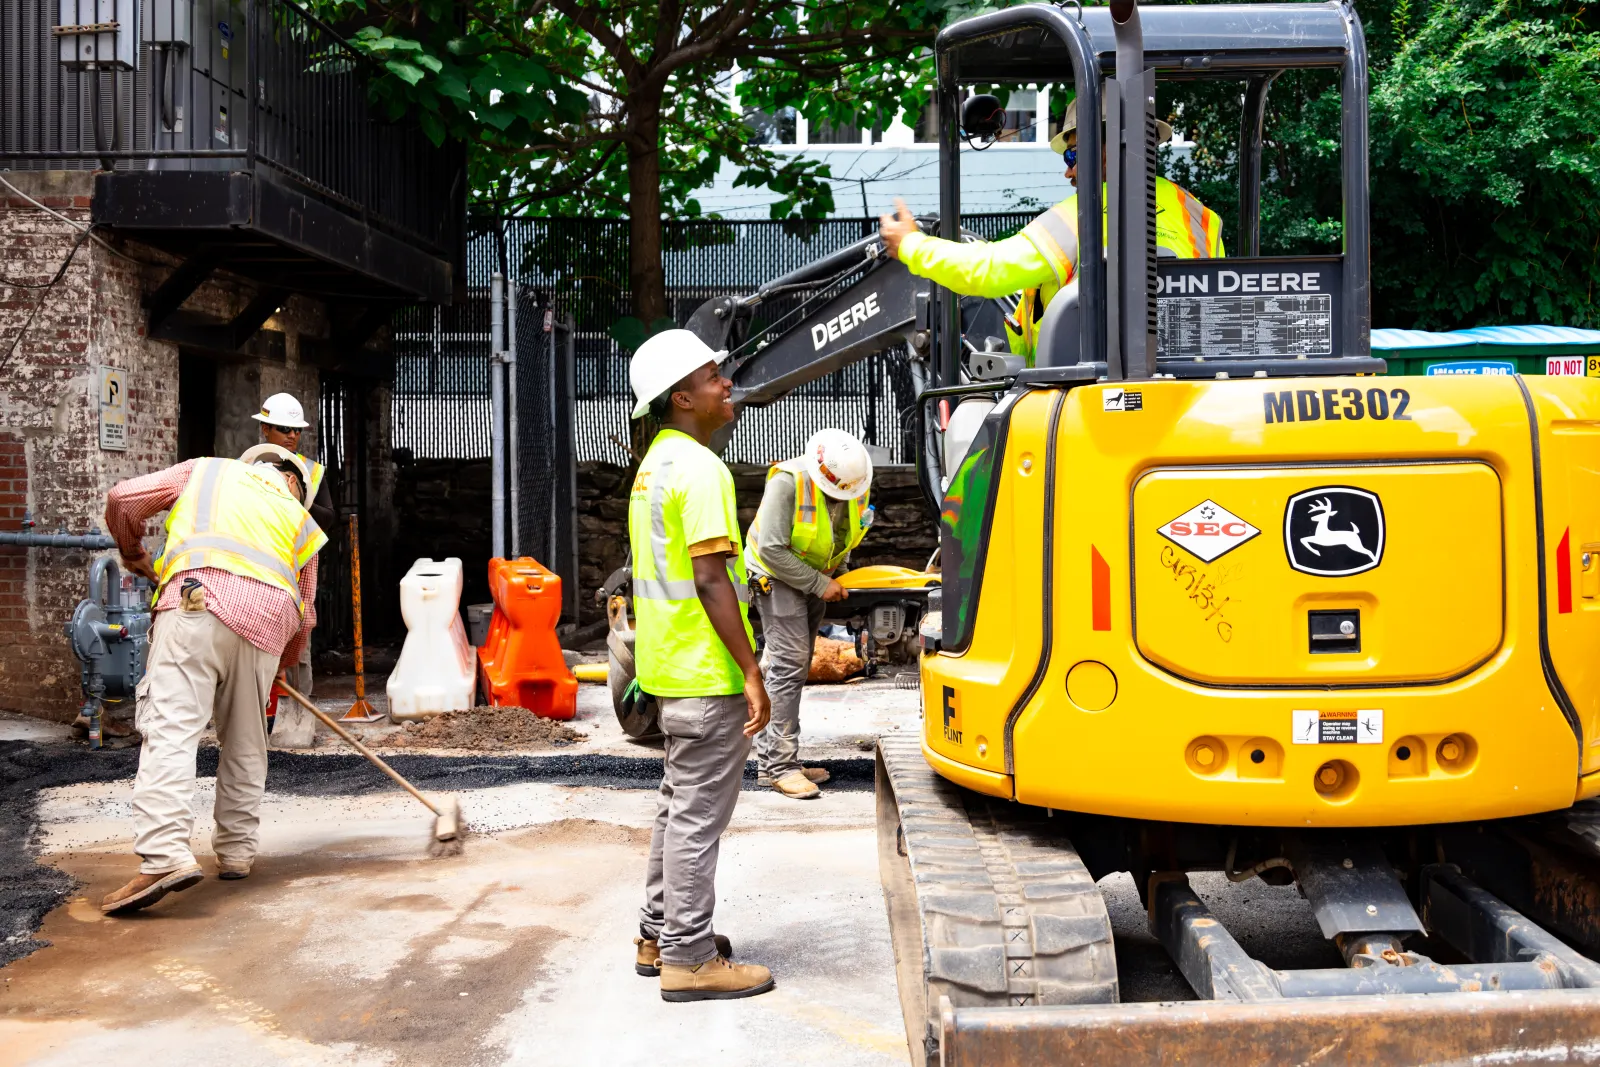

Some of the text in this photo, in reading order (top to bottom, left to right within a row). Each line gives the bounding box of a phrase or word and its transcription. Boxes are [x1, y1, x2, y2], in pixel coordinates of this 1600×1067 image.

[1157, 271, 1320, 293] HN DEERE
[811, 292, 881, 351] DEERE
[1548, 360, 1582, 375] DO NOT
[1263, 388, 1412, 424] MDE302
[1170, 522, 1247, 536] SEC
[944, 726, 962, 744] FLINT
